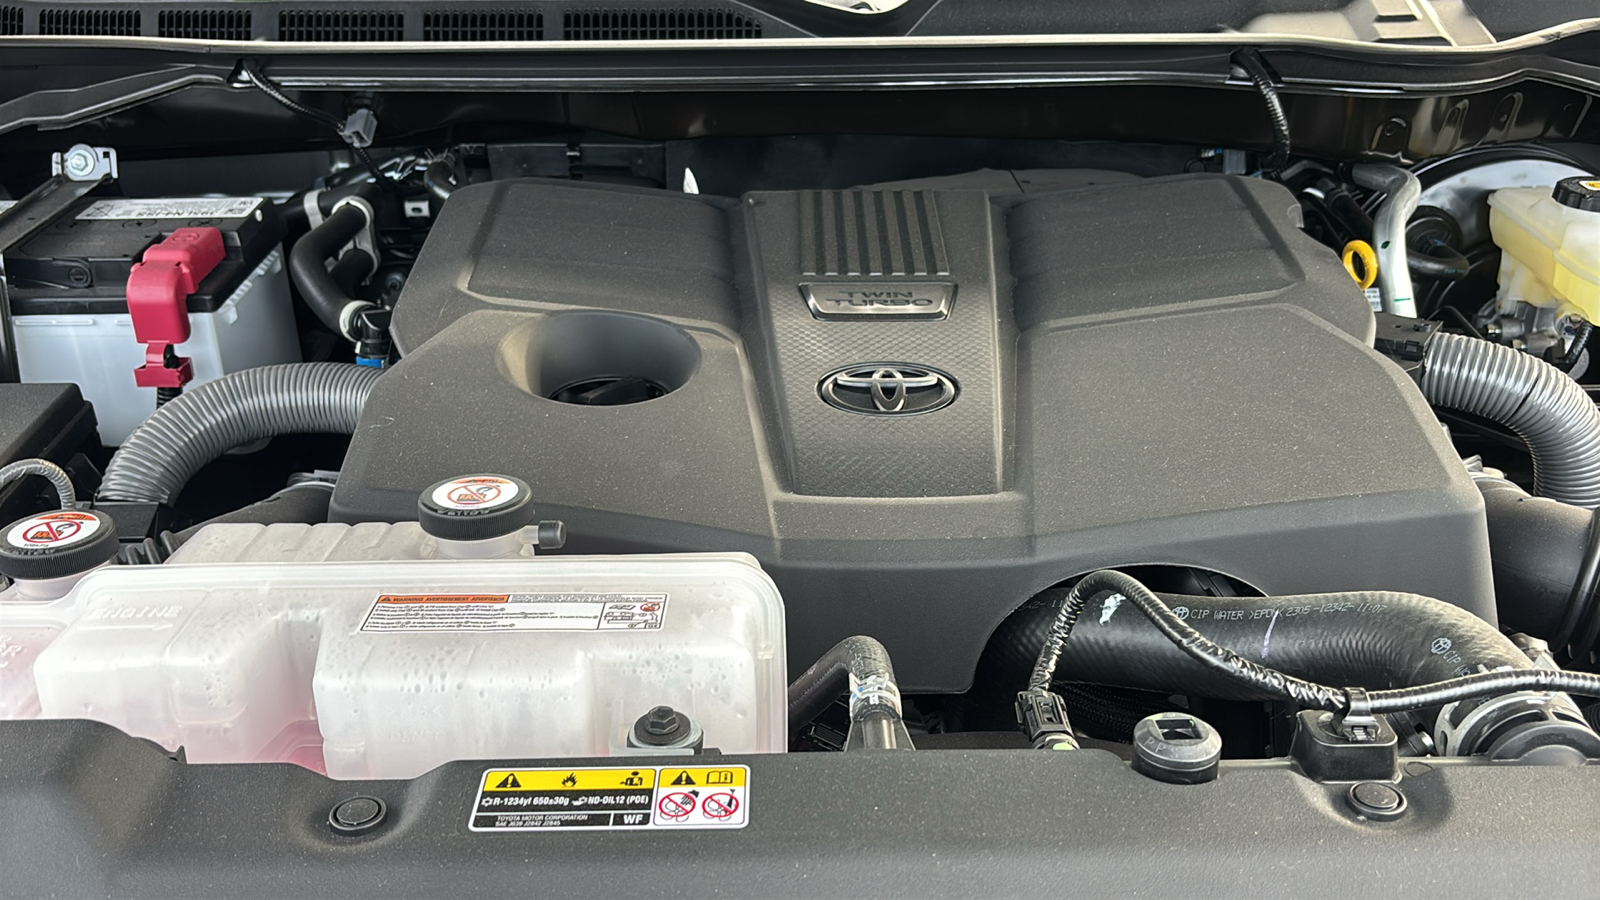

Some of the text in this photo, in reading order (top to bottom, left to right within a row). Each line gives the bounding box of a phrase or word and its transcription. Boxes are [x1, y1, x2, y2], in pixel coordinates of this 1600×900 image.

[826, 298, 933, 307] TURBO
[87, 606, 183, 620] ENGINE
[1190, 610, 1210, 619] CIP
[1214, 610, 1243, 620] WATER
[1286, 606, 1312, 617] 2305
[1443, 650, 1462, 665] CIP
[493, 797, 533, 807] R-1234yf
[626, 795, 649, 805] (POE)
[623, 814, 644, 825] WF
